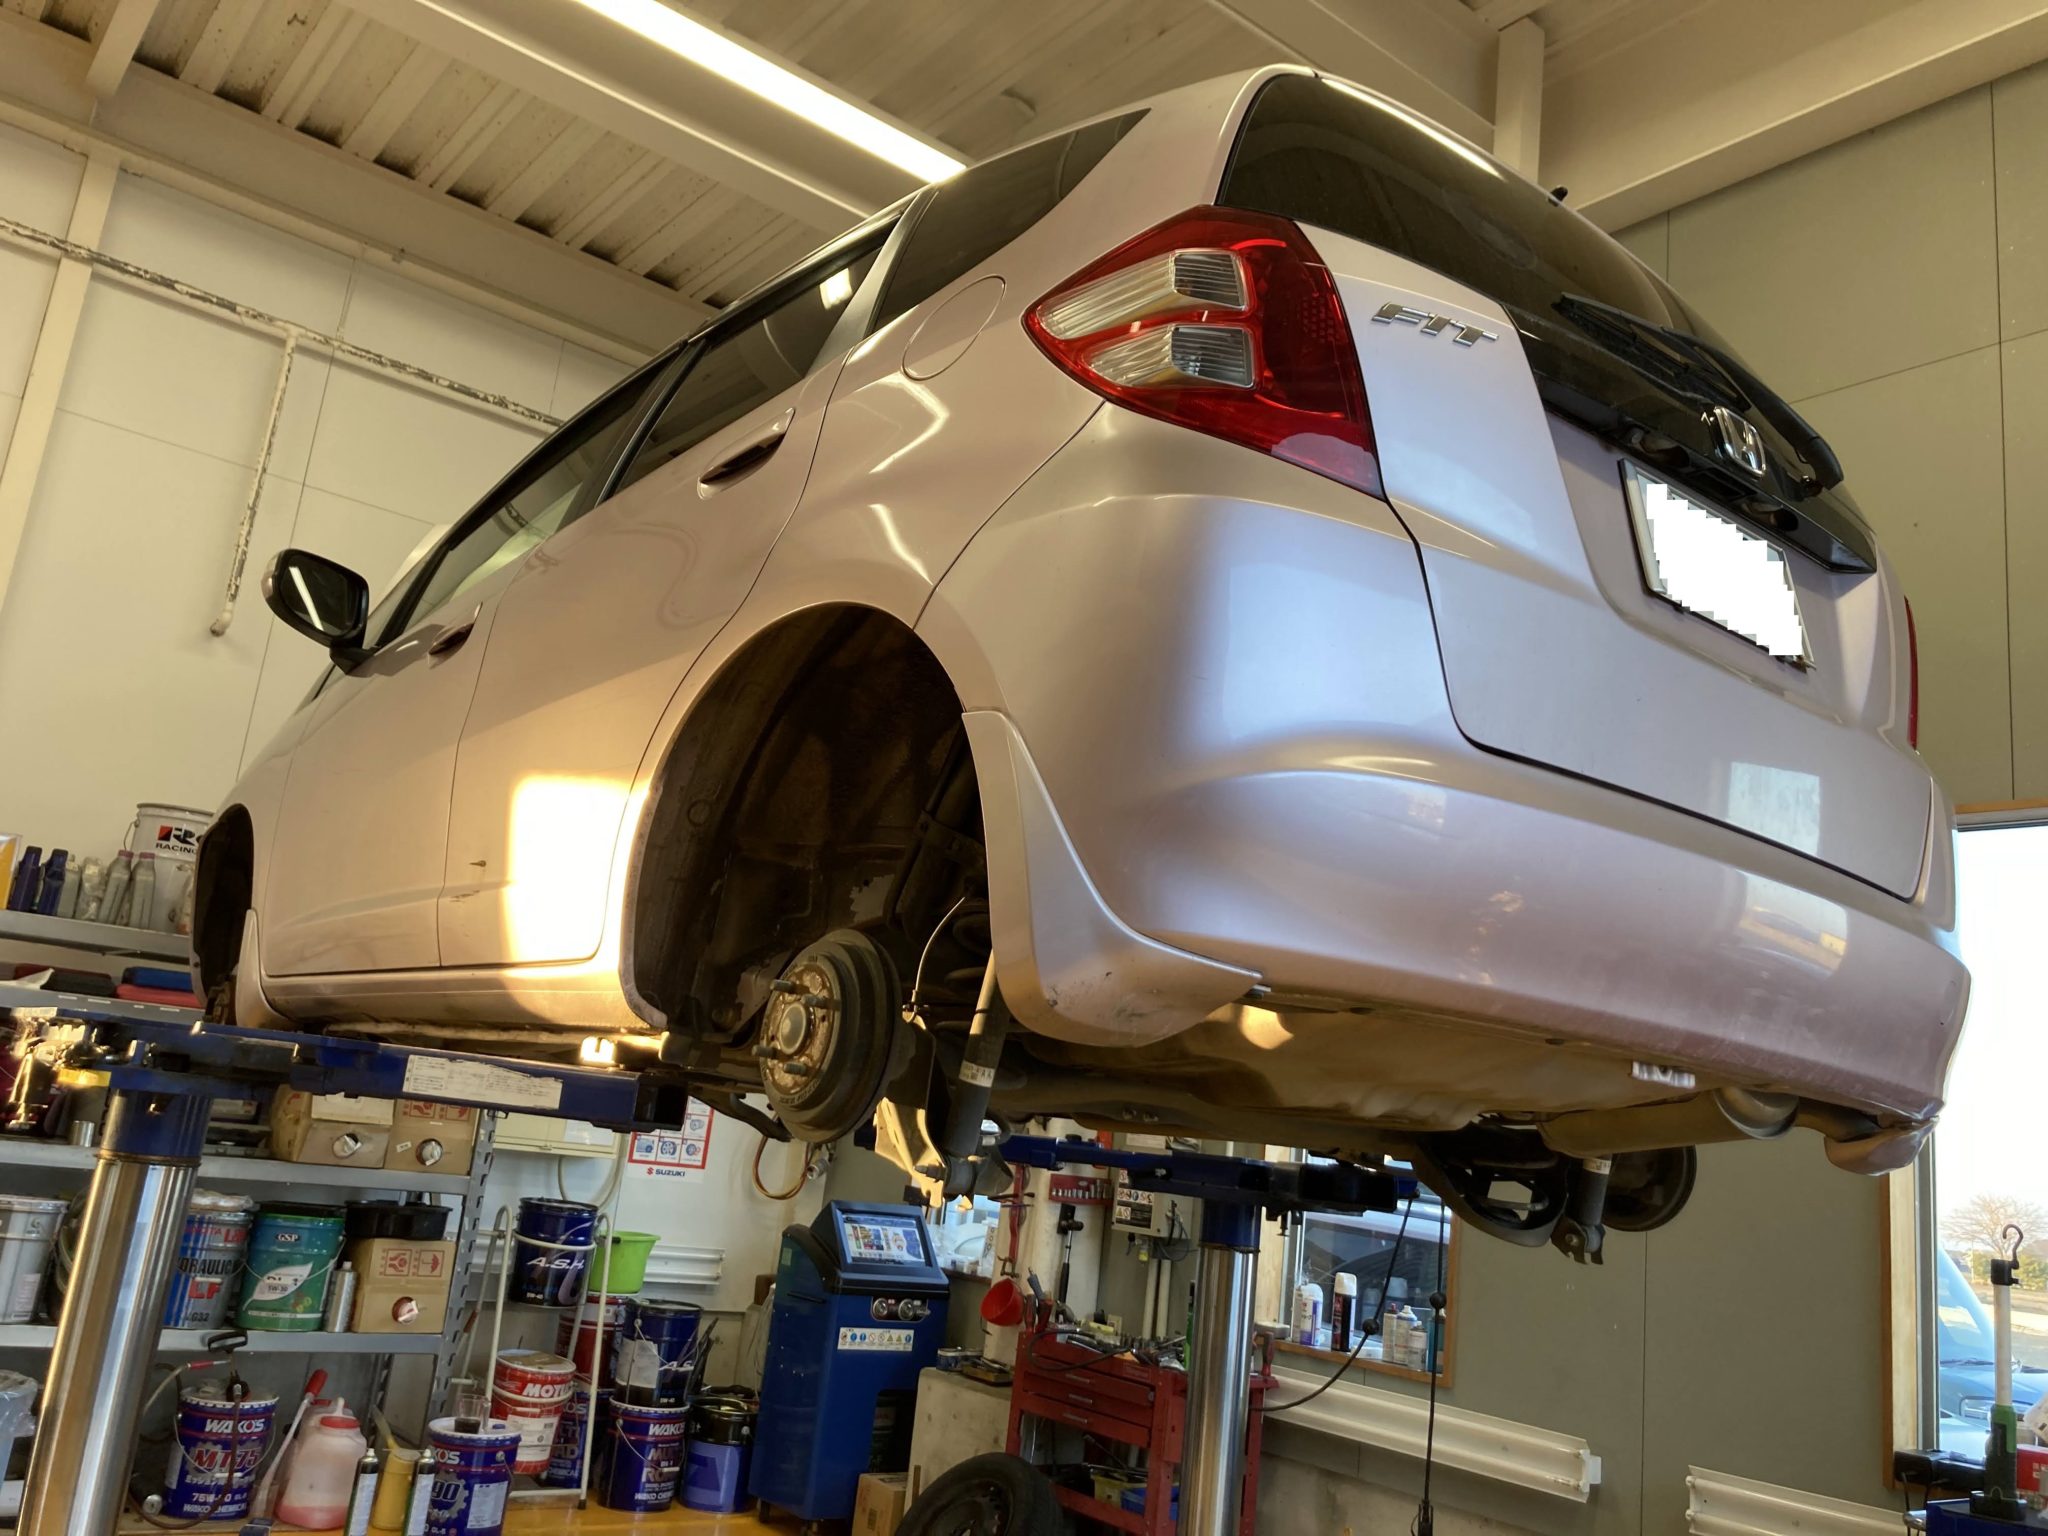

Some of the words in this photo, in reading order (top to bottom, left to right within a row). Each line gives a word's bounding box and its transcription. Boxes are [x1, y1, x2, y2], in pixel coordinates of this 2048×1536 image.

[1371, 302, 1499, 347] FIT
[655, 1168, 686, 1177] SUZUKI
[278, 1232, 299, 1242] GSP
[176, 1257, 236, 1277] DRAULIC
[183, 1503, 212, 1514] WAKO
